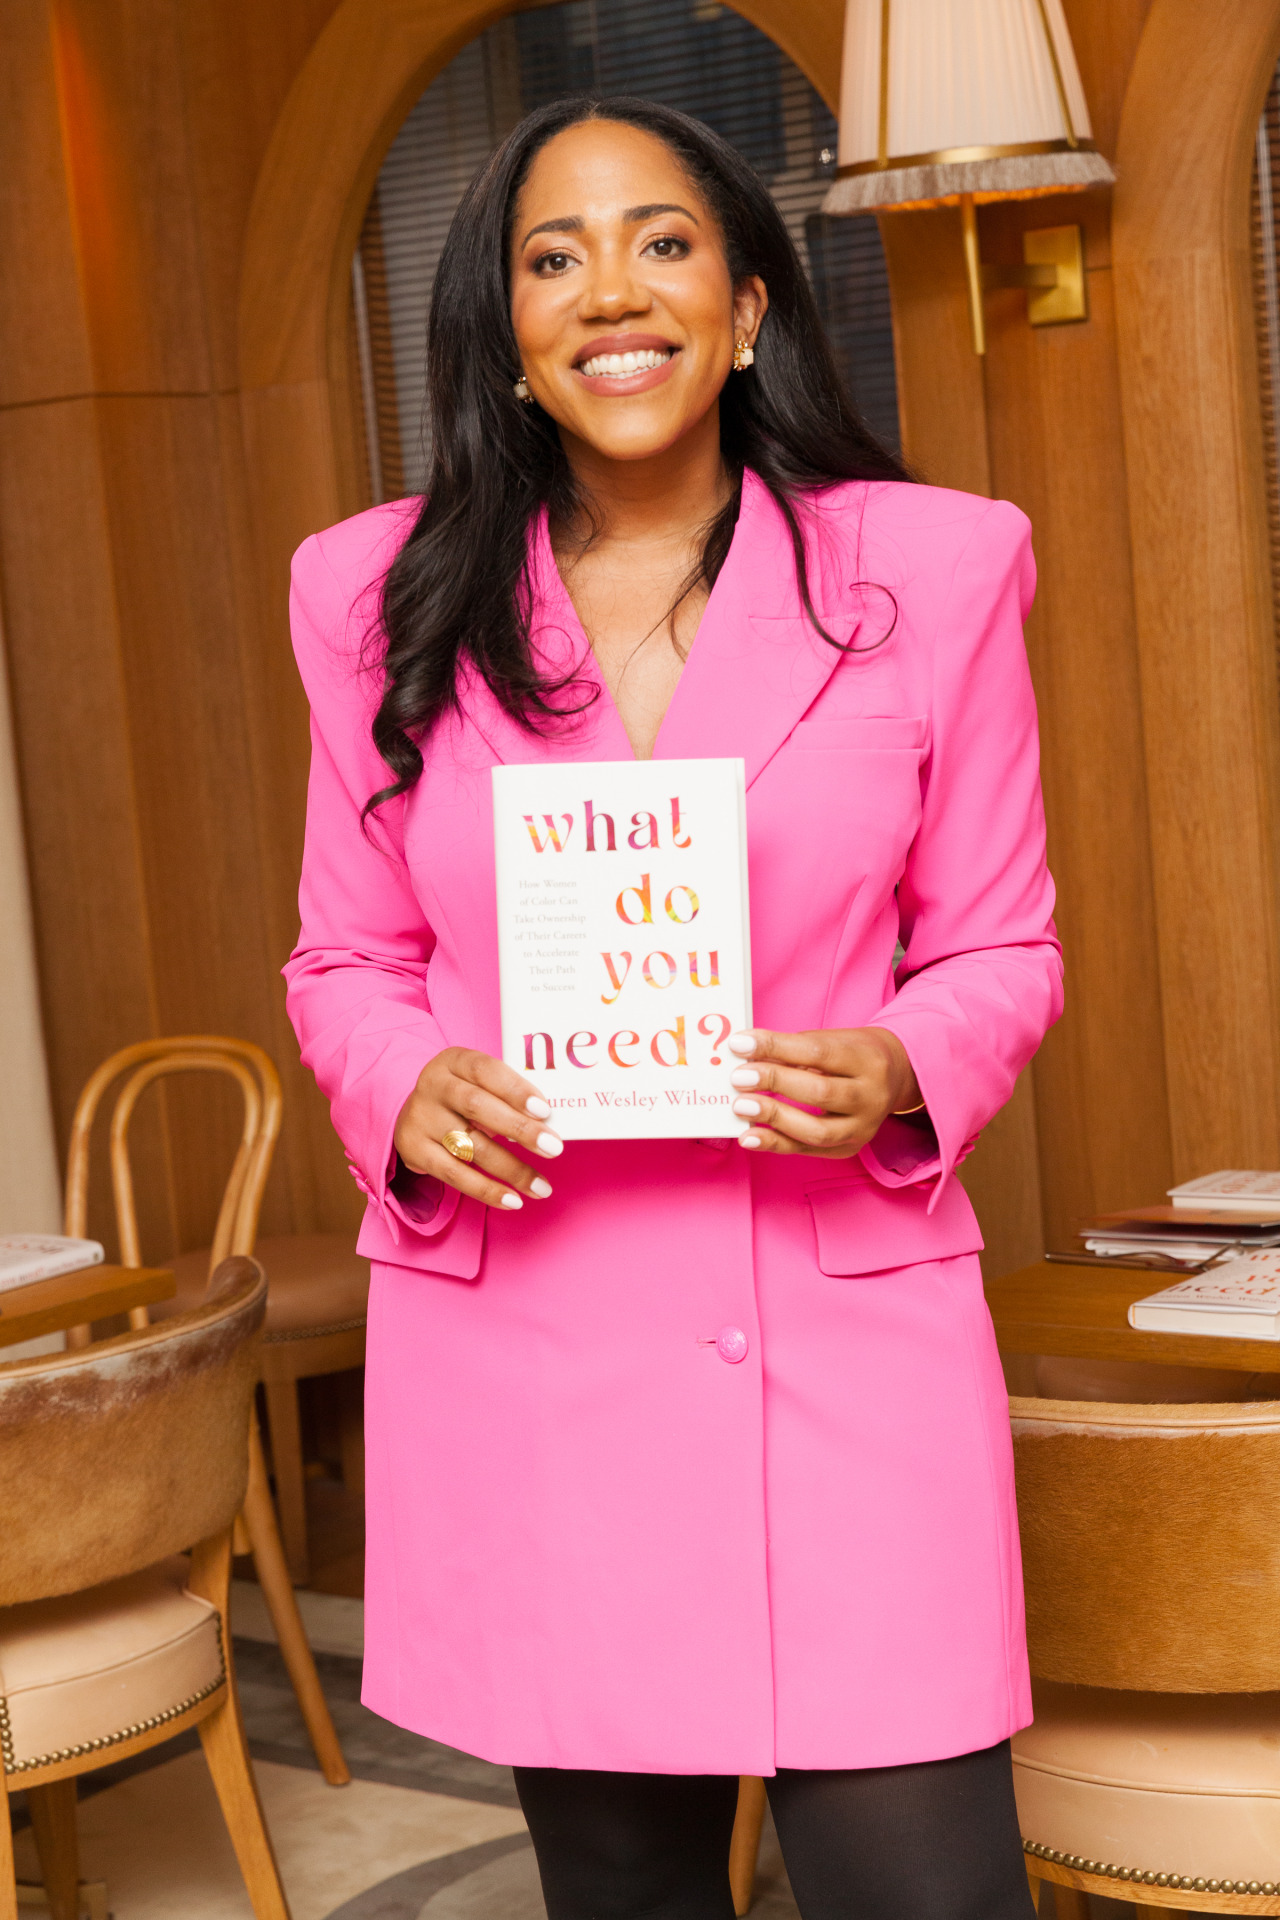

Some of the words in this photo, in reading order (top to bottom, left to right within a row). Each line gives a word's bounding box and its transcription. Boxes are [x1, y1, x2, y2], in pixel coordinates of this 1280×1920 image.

[522, 796, 692, 853] what
[520, 880, 540, 889] How
[543, 879, 577, 888] Women
[520, 897, 529, 906] of
[531, 896, 556, 906] Color
[559, 896, 578, 905] Can
[615, 873, 700, 925] do
[514, 915, 534, 924] Take
[537, 913, 586, 924] Ownership
[515, 932, 524, 941] of
[526, 931, 551, 941] Their
[553, 930, 587, 940] Careers
[523, 950, 532, 958] to
[535, 948, 579, 958] Accelerate
[529, 966, 553, 975] Their
[556, 965, 576, 975] Path
[600, 950, 721, 1005] you
[531, 984, 540, 992] to
[543, 983, 575, 992] Success
[522, 1013, 732, 1071] need?
[547, 1097, 588, 1109] uren
[595, 1091, 658, 1111] Wesley
[664, 1089, 731, 1106] Wilson
